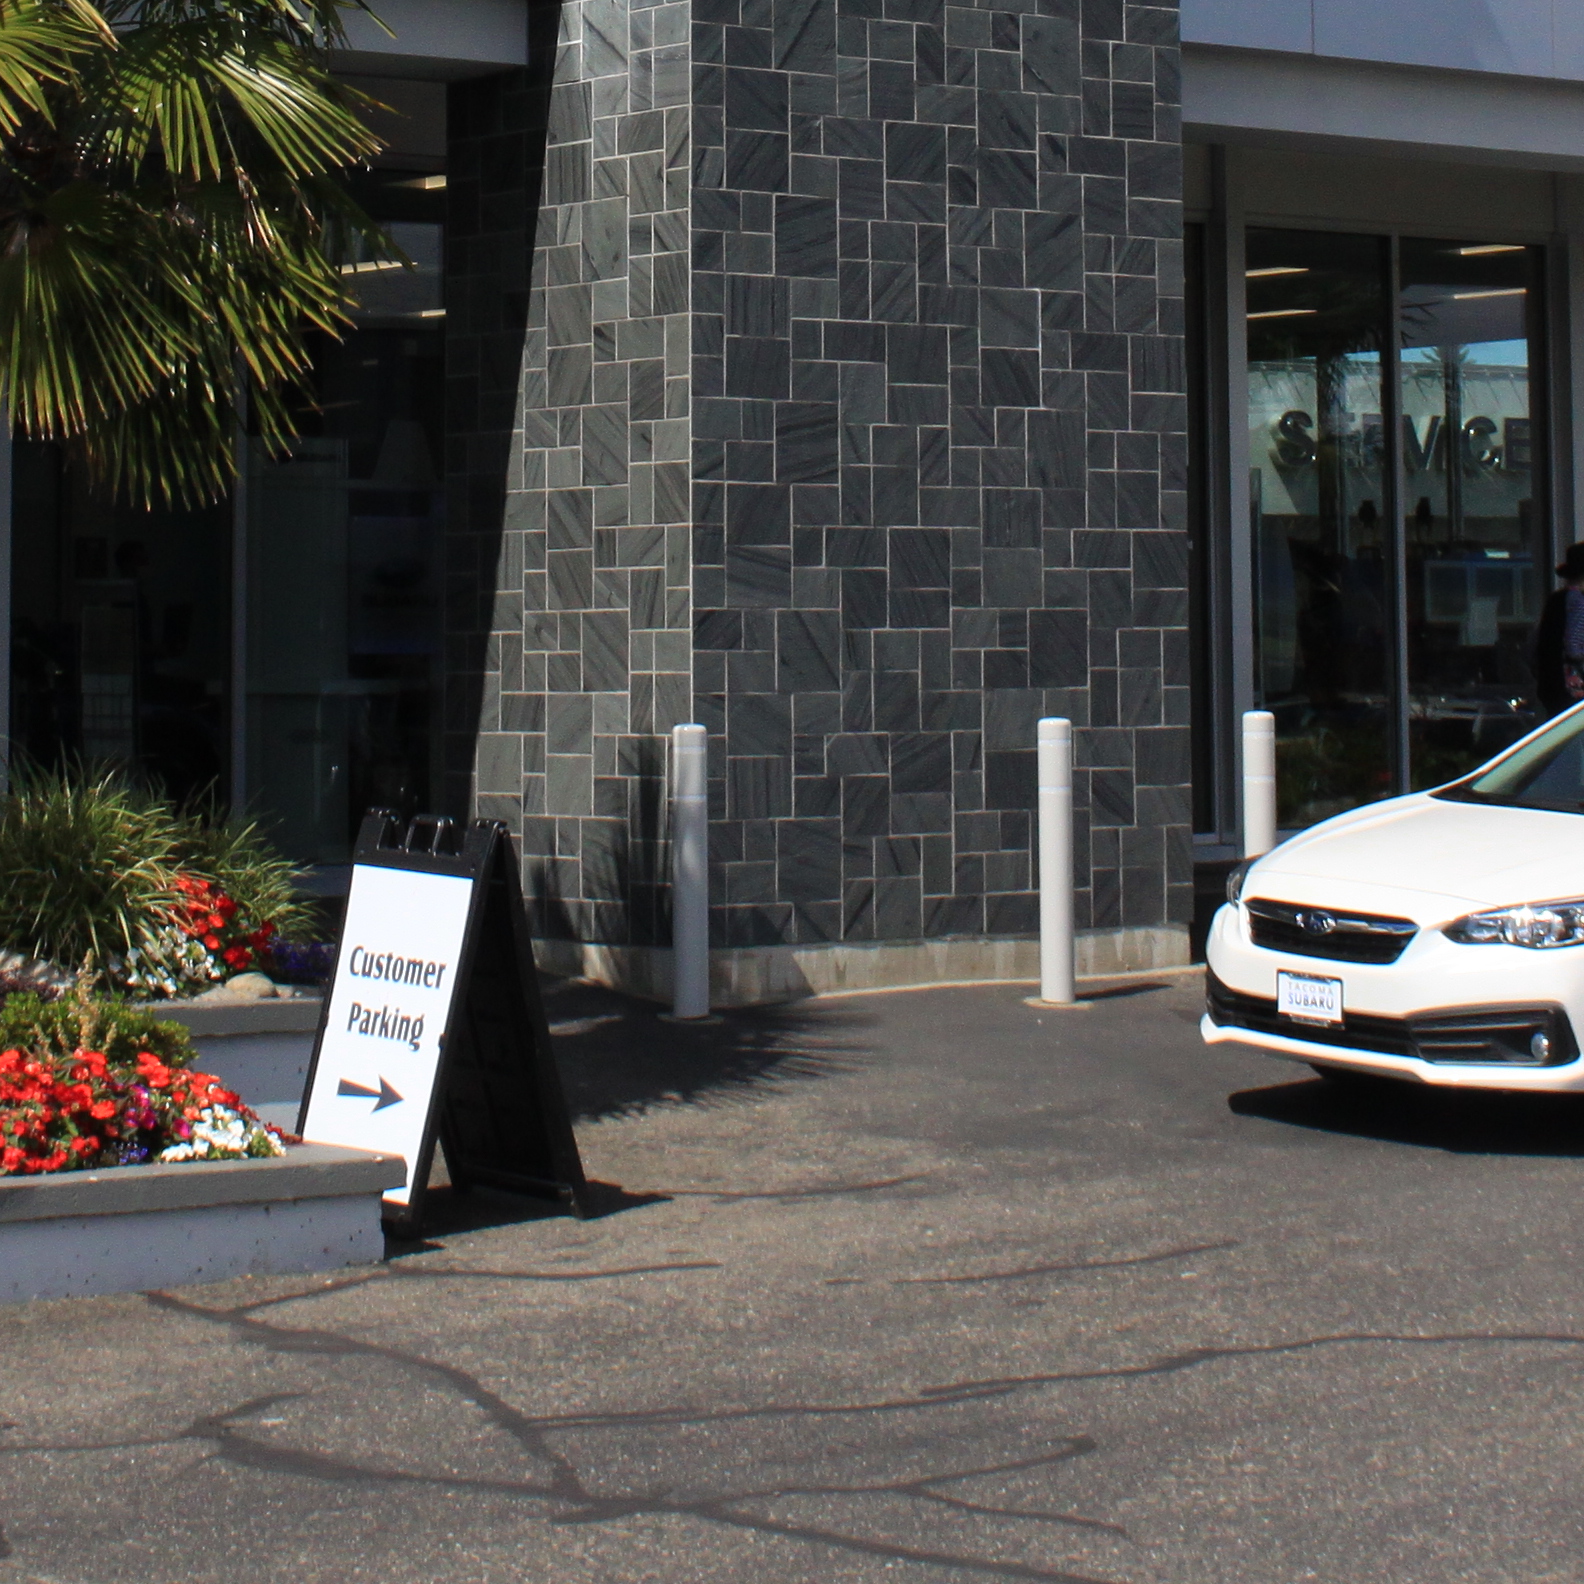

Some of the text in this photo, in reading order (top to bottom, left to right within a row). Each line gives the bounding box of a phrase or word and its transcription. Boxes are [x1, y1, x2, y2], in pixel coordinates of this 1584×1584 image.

[349, 945, 447, 989] Customer
[1287, 980, 1334, 996] TACOMA
[1288, 992, 1334, 1010] SUBARU
[347, 1001, 425, 1052] Parking
